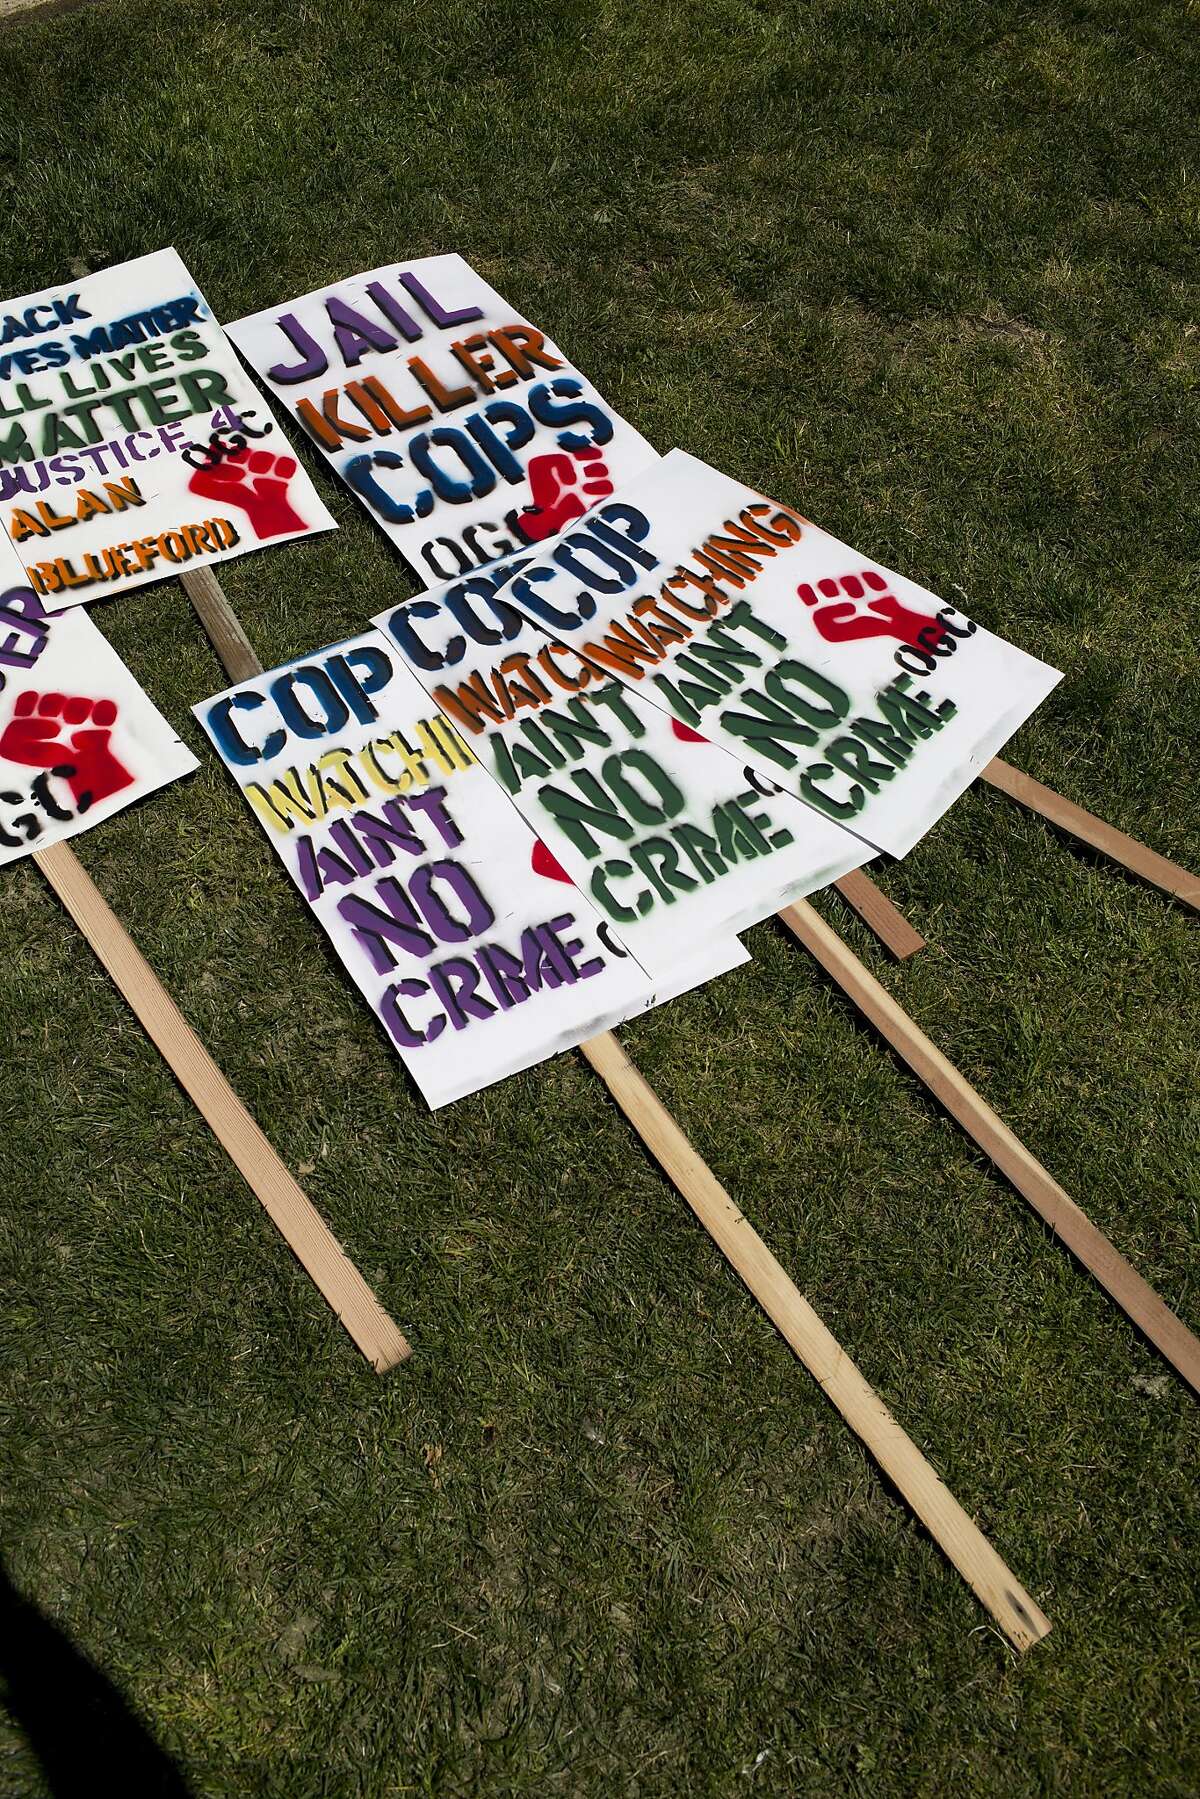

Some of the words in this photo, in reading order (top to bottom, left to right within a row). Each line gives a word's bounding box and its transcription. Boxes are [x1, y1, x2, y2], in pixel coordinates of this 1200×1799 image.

[0, 294, 92, 345] ACK
[60, 331, 210, 398] LIVES
[70, 297, 207, 359] MATTER
[267, 271, 484, 385] JAIL
[181, 410, 273, 470] OGC
[296, 324, 566, 453] KILLER
[0, 421, 194, 501] JUSTICE
[10, 475, 147, 542] ALAN
[344, 378, 615, 524] COPS
[27, 517, 241, 595] BLUEFORD
[511, 502, 661, 631] COP
[583, 503, 802, 681] WATCHING
[389, 557, 537, 671] CO
[653, 600, 788, 729] AINT
[894, 605, 977, 677] OGC
[206, 645, 394, 767] COP
[488, 680, 646, 796] AINT
[720, 658, 850, 770] NO
[799, 672, 958, 819] CRIME
[297, 785, 466, 902] AINT
[537, 747, 687, 860] NO
[590, 789, 796, 924] CRIME
[335, 858, 496, 976] NO
[380, 912, 606, 1048] CRIME
